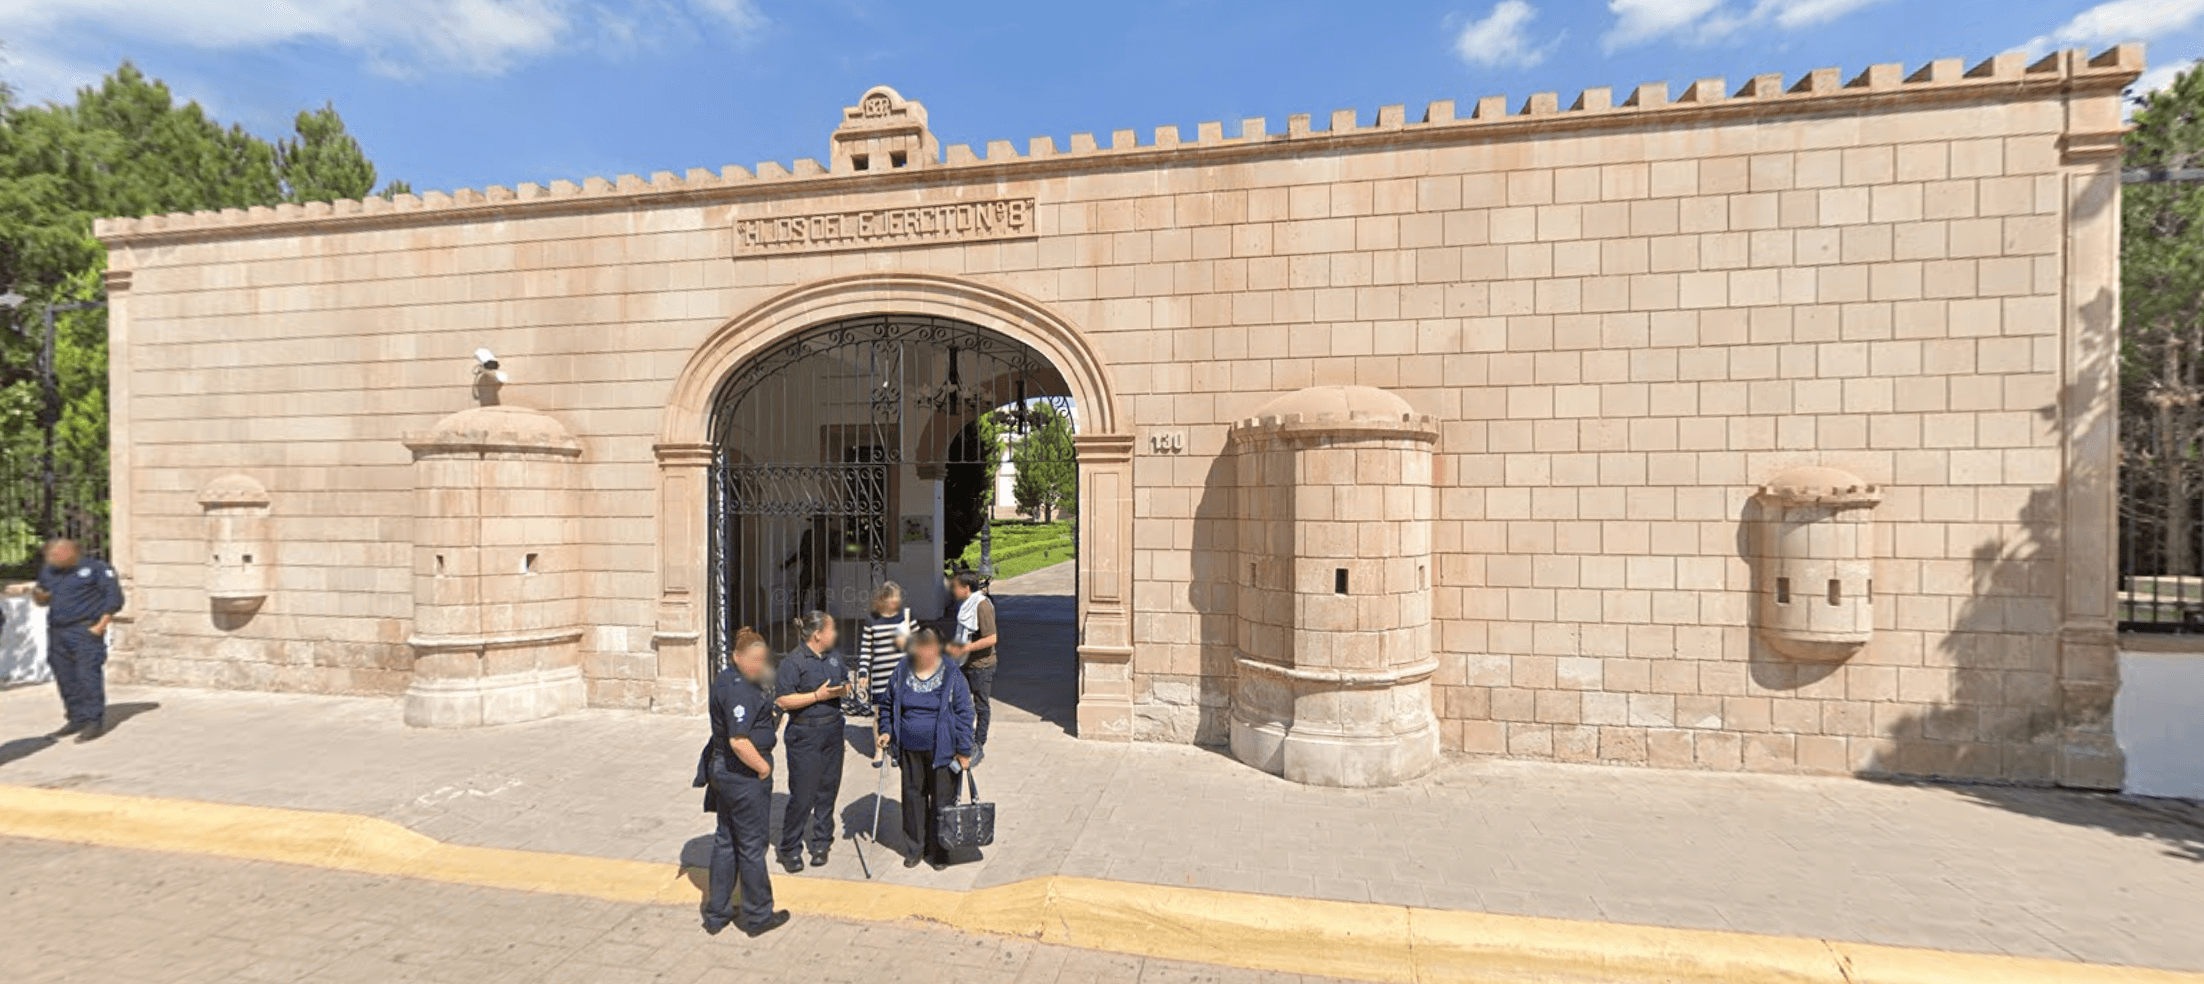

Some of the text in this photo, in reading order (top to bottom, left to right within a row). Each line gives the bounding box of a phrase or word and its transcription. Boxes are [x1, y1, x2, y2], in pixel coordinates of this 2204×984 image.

[811, 214, 854, 240] DEL
[858, 204, 972, 238] EJERCITO
[1150, 431, 1185, 450] 130
